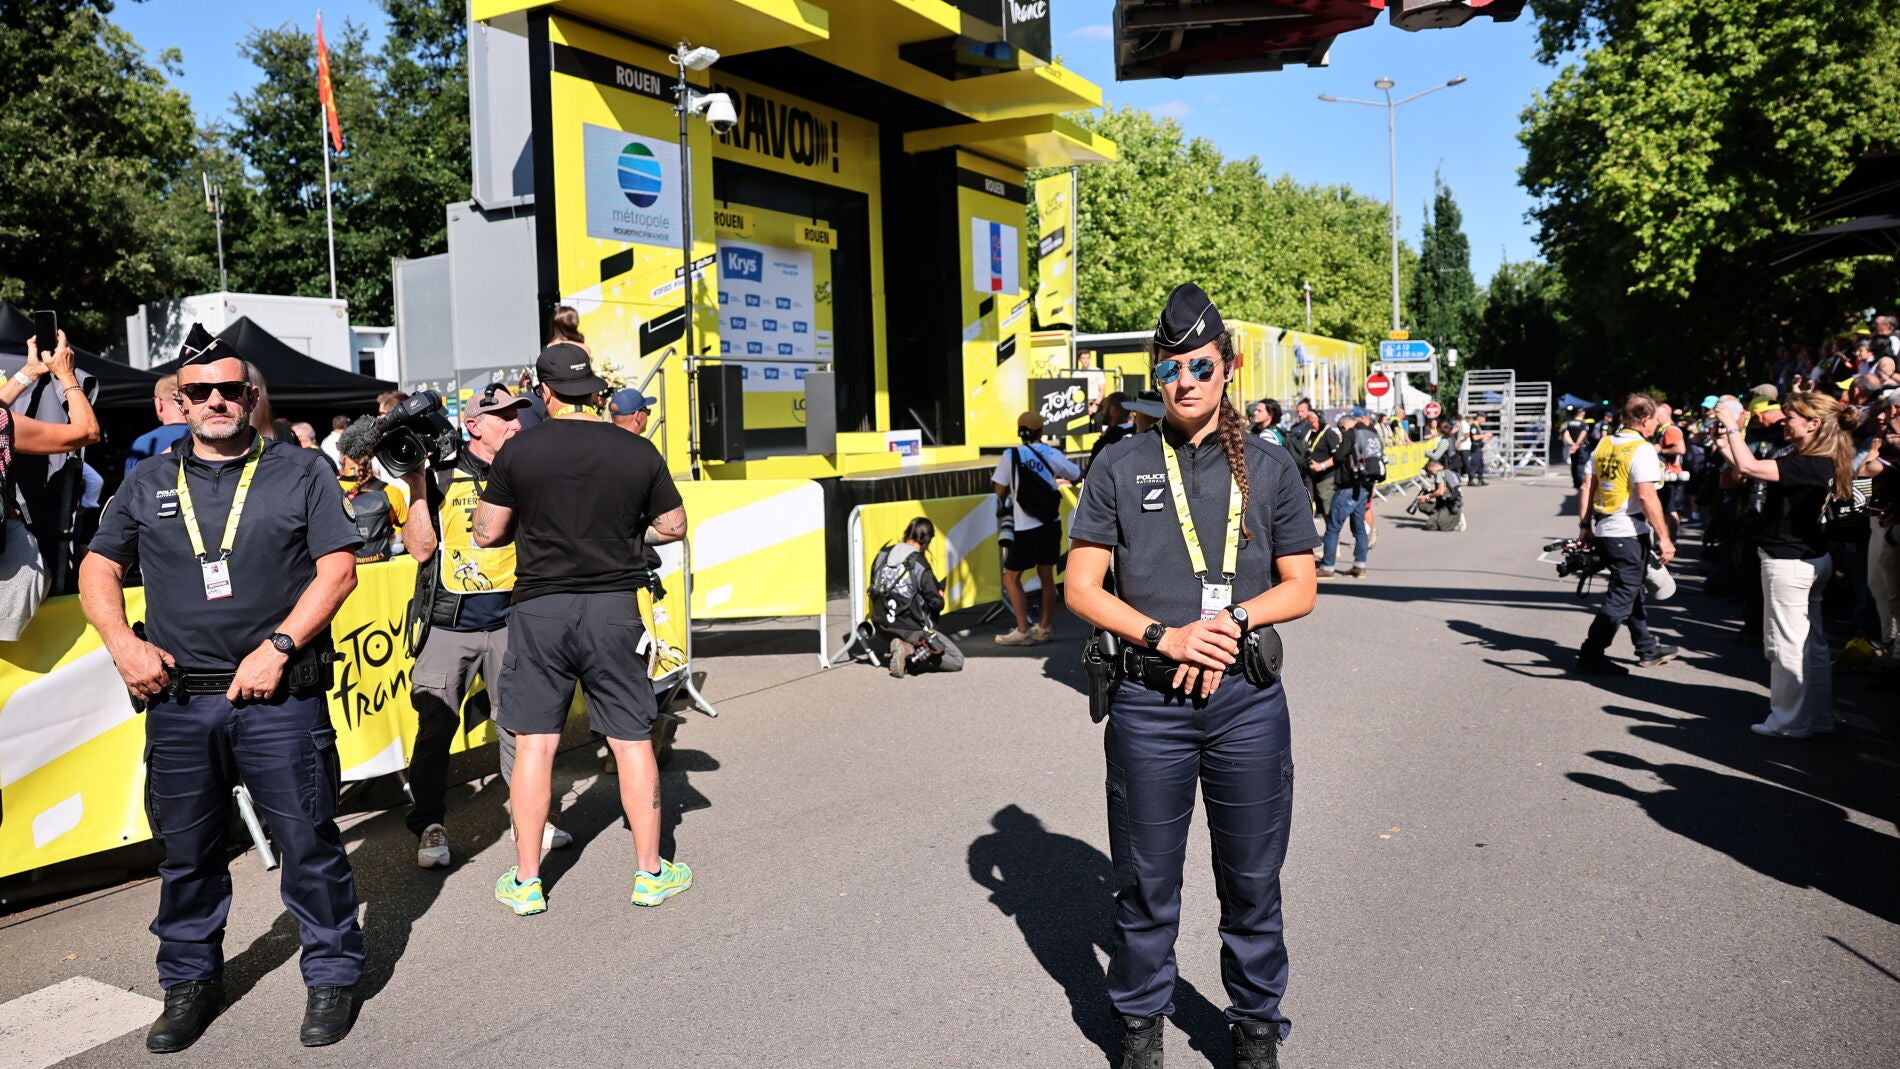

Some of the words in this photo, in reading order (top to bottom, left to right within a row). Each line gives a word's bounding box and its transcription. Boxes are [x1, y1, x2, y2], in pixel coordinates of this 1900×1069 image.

[615, 65, 661, 96] ROUEN
[612, 208, 669, 230] métropole
[714, 211, 744, 230] ROUEN
[804, 228, 830, 245] ROUEN
[728, 252, 757, 275] Krys
[1136, 473, 1165, 481] POLICE
[452, 497, 479, 507] INTER
